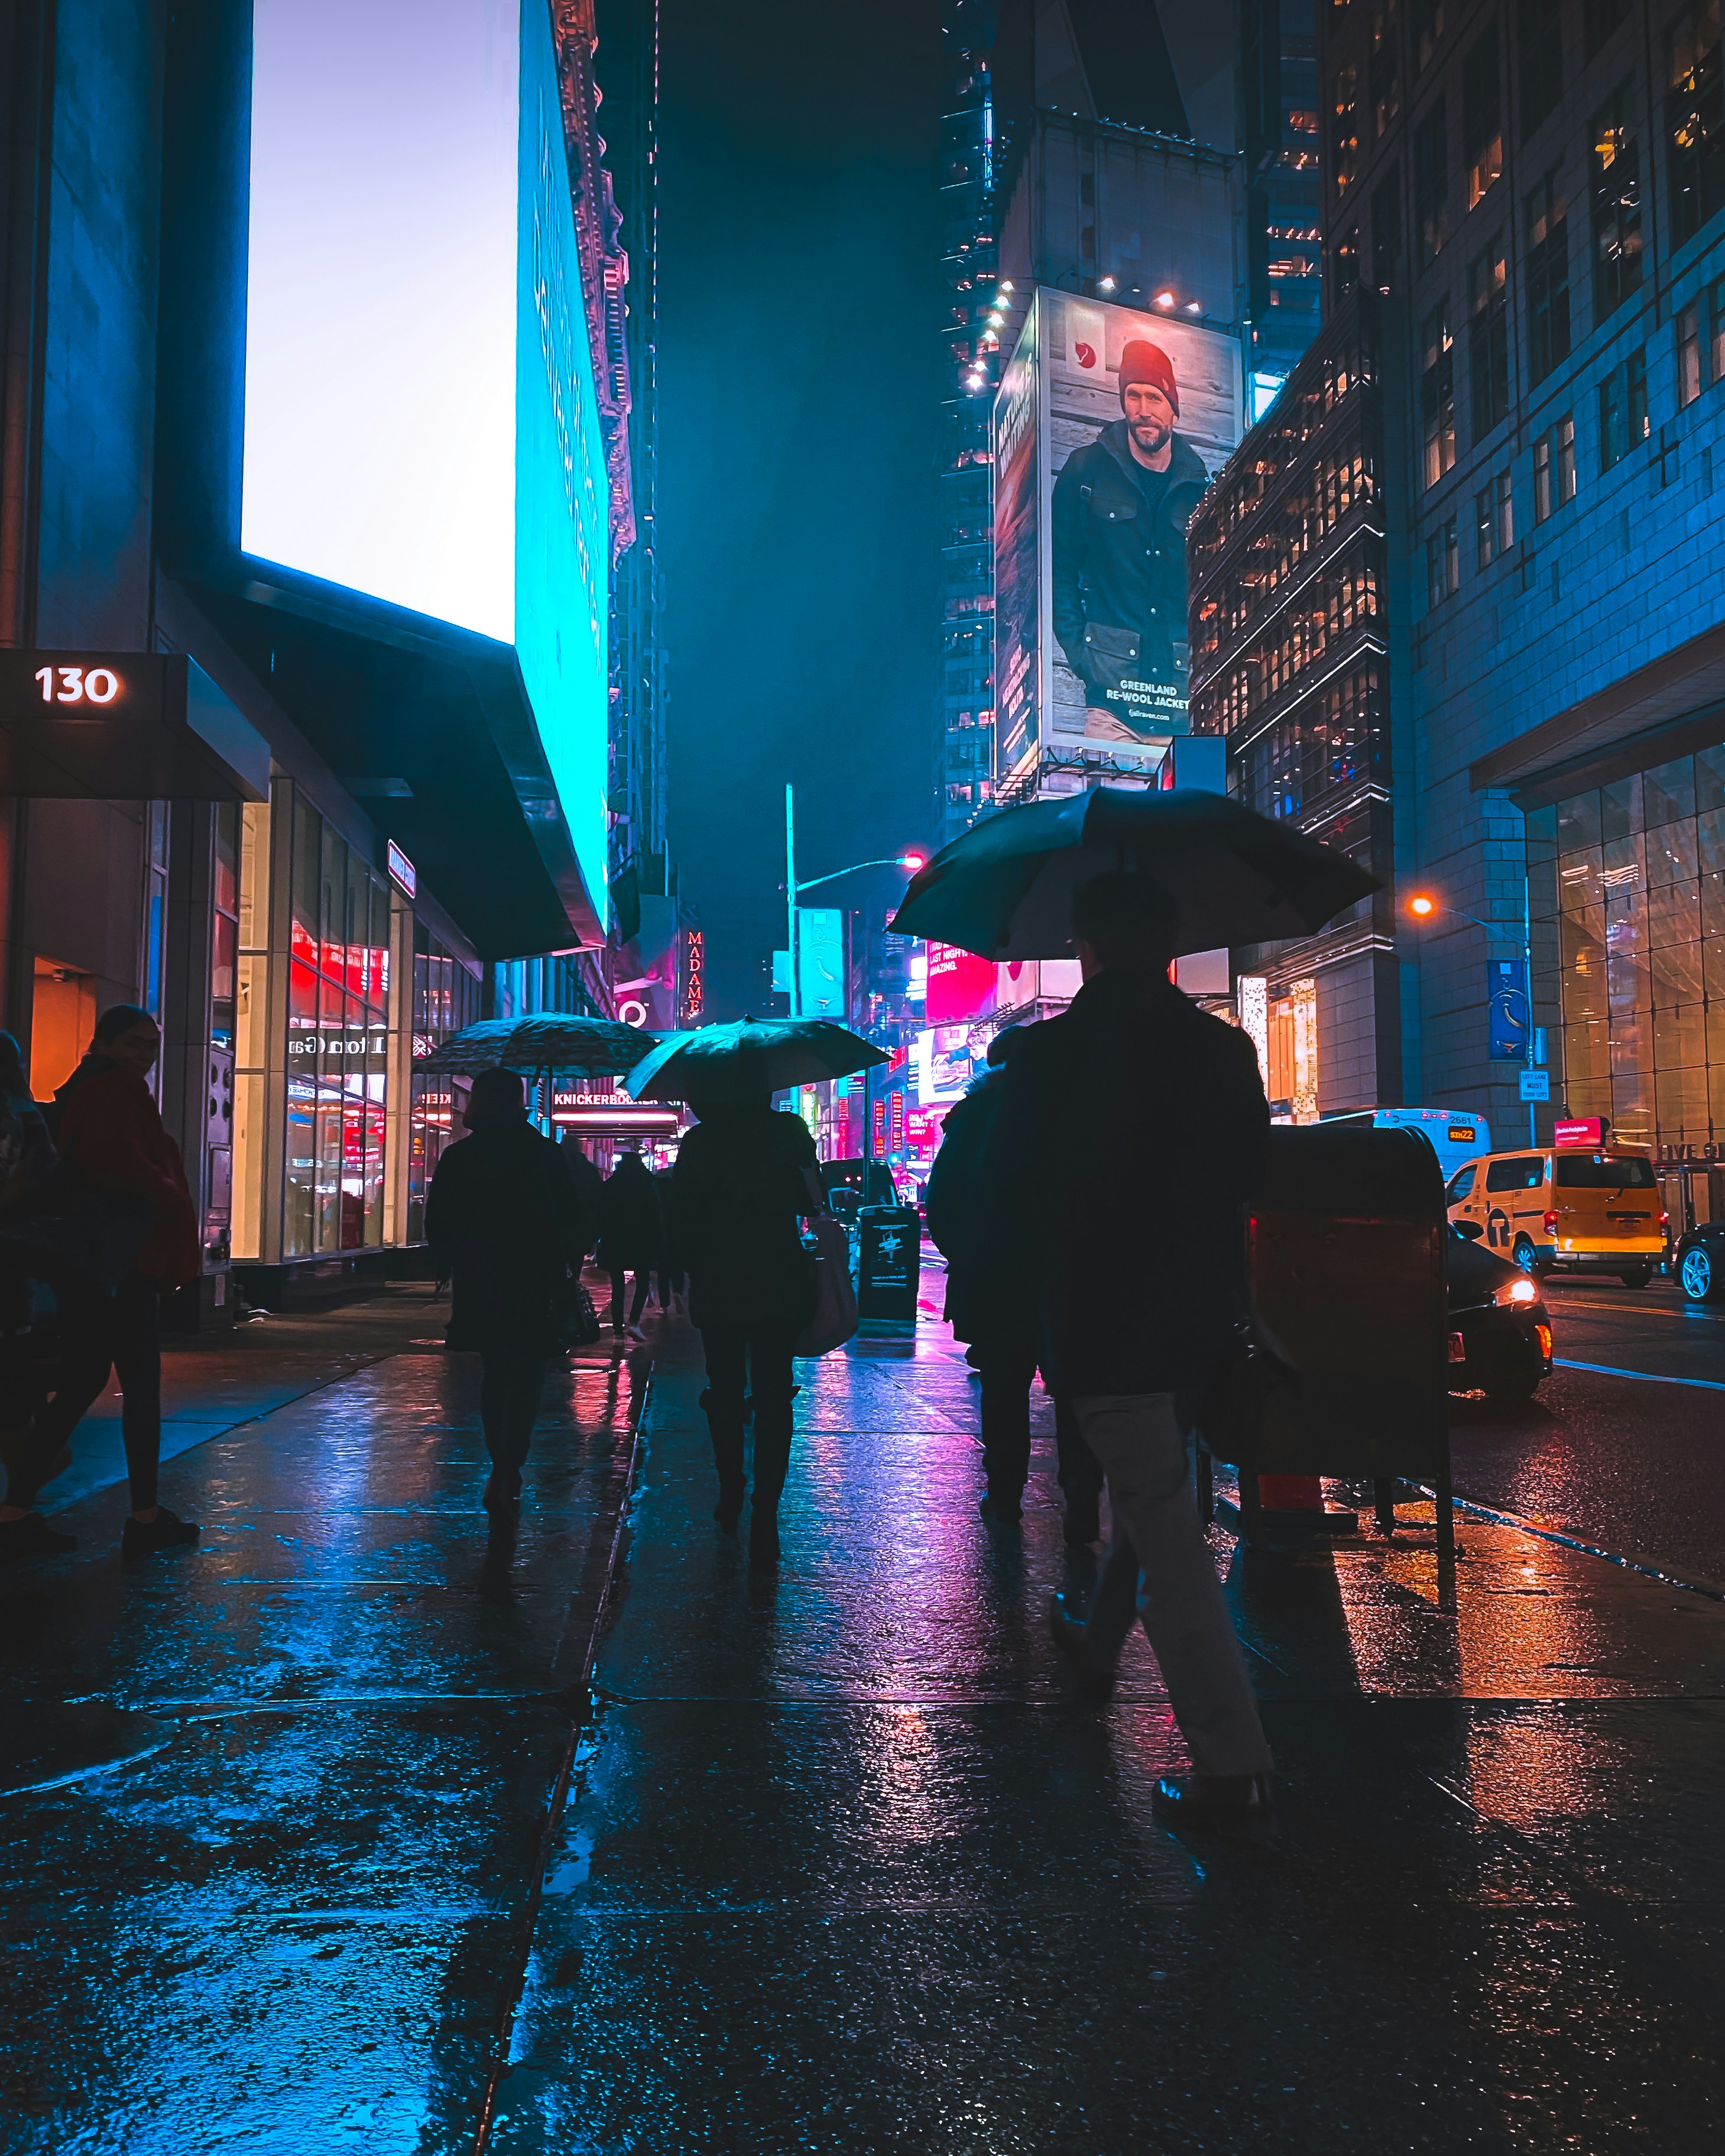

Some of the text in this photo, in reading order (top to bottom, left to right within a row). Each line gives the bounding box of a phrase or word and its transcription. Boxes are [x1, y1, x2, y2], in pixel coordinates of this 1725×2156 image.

[1000, 391, 1030, 479] WAITING
[35, 667, 118, 703] 130
[1120, 680, 1178, 696] GREENLAND
[1106, 689, 1191, 710] RE-WOOL JACKET
[930, 952, 941, 965] LAST
[688, 932, 702, 1013] MADAME
[929, 960, 957, 977] AMAZING.
[1450, 1116, 1471, 1124] 2661
